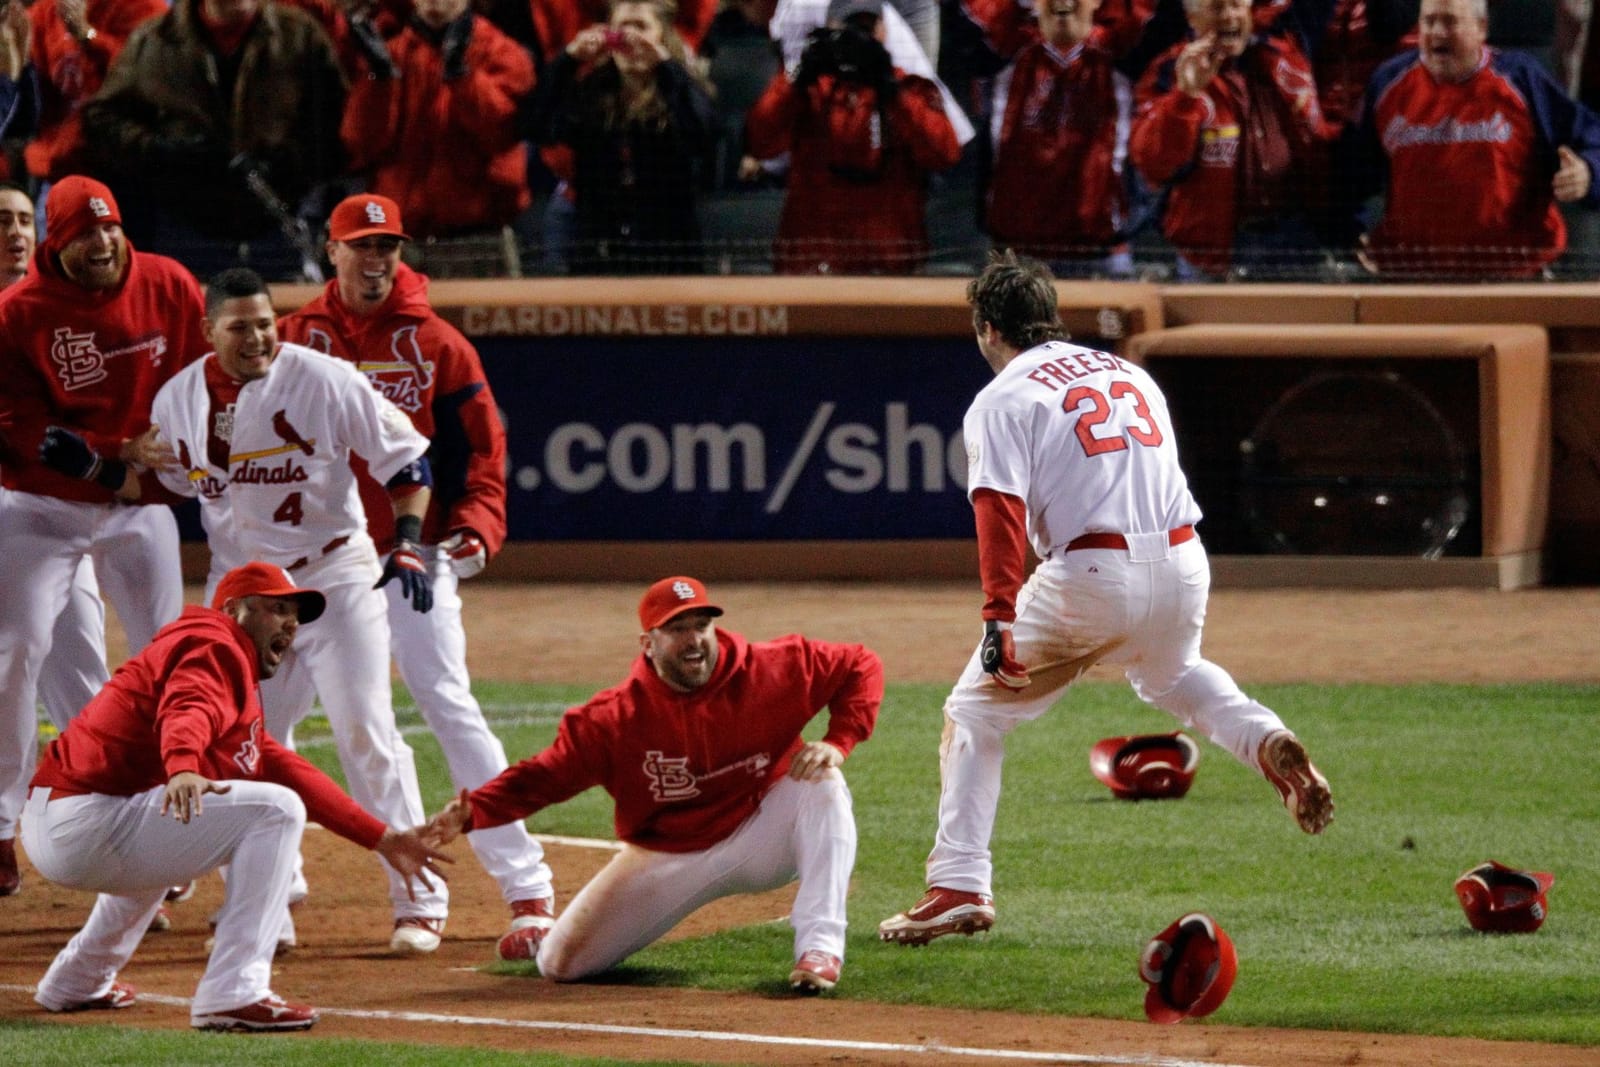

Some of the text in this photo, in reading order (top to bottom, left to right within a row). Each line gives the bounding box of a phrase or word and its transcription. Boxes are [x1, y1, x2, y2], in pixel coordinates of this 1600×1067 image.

[463, 304, 788, 336] CARDINALS.COM
[1027, 351, 1132, 391] FREESE
[1062, 380, 1163, 457] 23
[273, 492, 304, 526] 4
